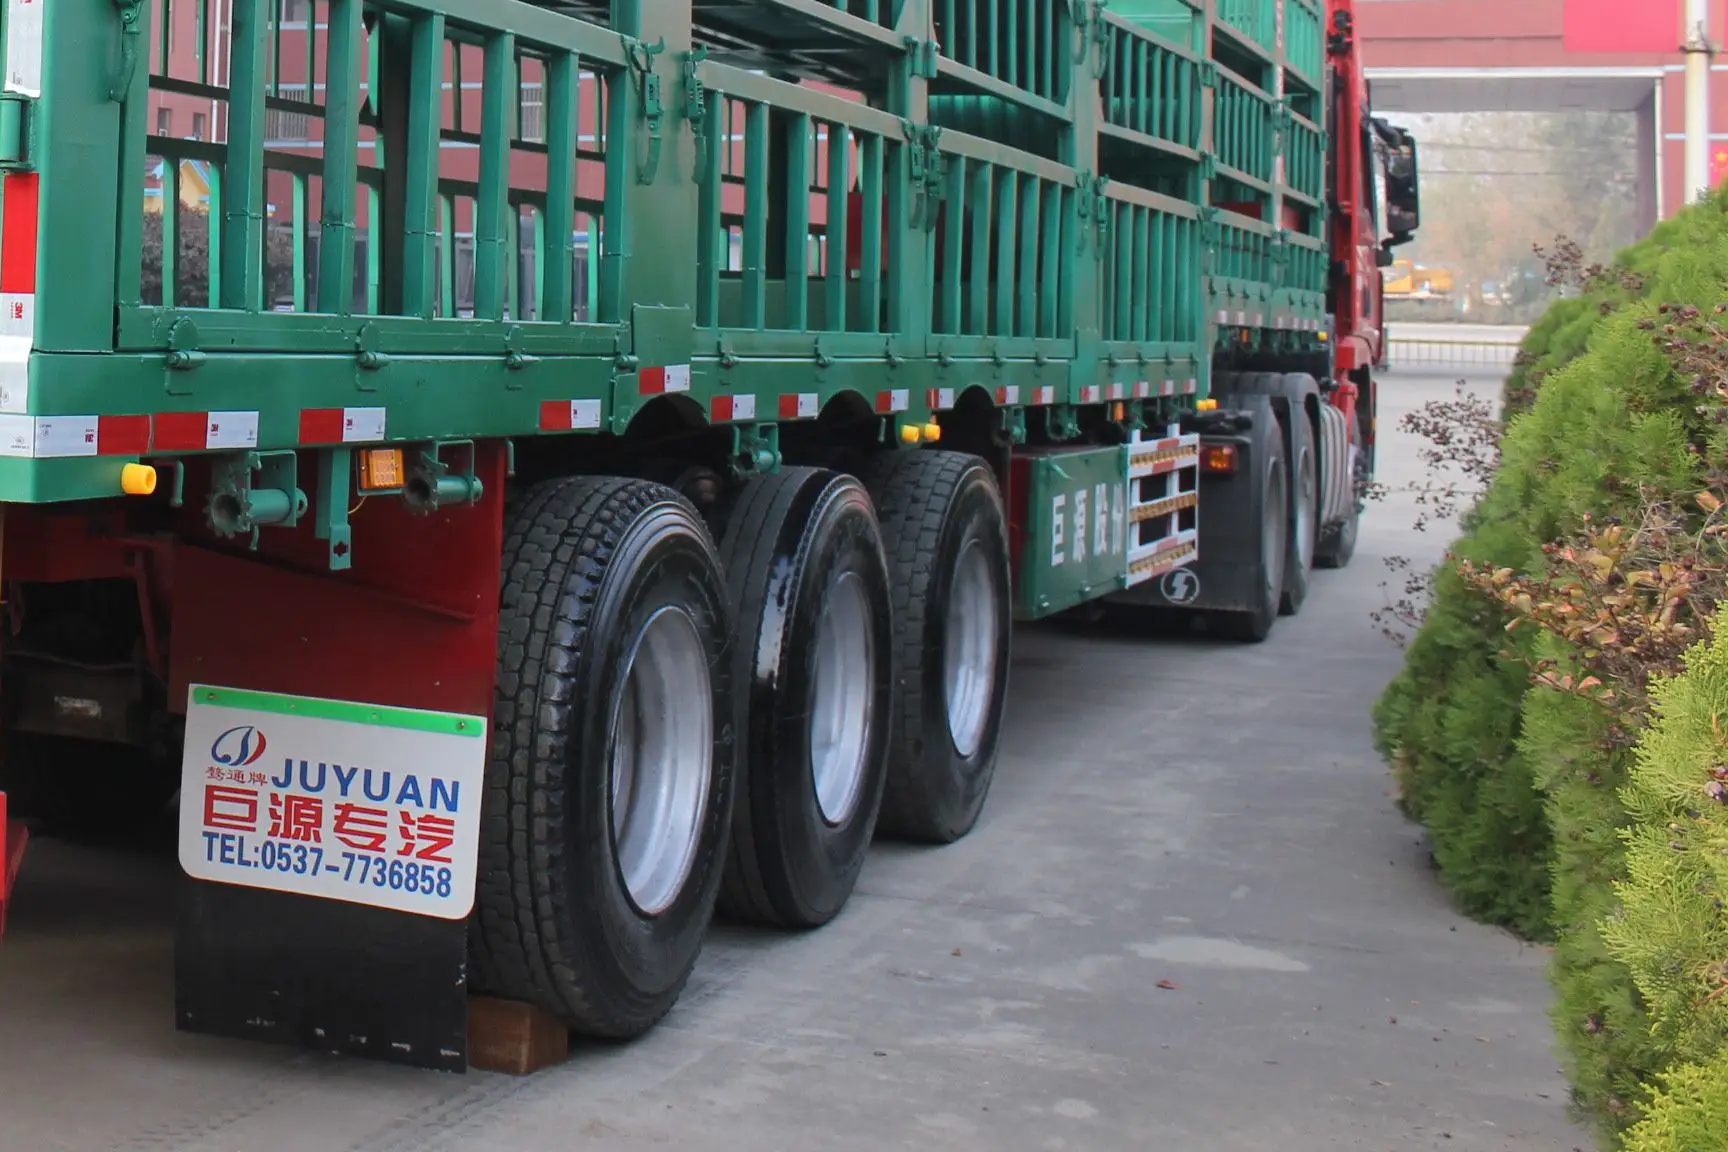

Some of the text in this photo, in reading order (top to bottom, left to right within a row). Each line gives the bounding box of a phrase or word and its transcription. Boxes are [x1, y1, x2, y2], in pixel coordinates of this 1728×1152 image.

[15, 302, 23, 319] 3M
[271, 758, 460, 813] JUYUAN
[203, 785, 456, 863] 巨源专汽
[202, 831, 452, 899] TEL:0537-7736858
